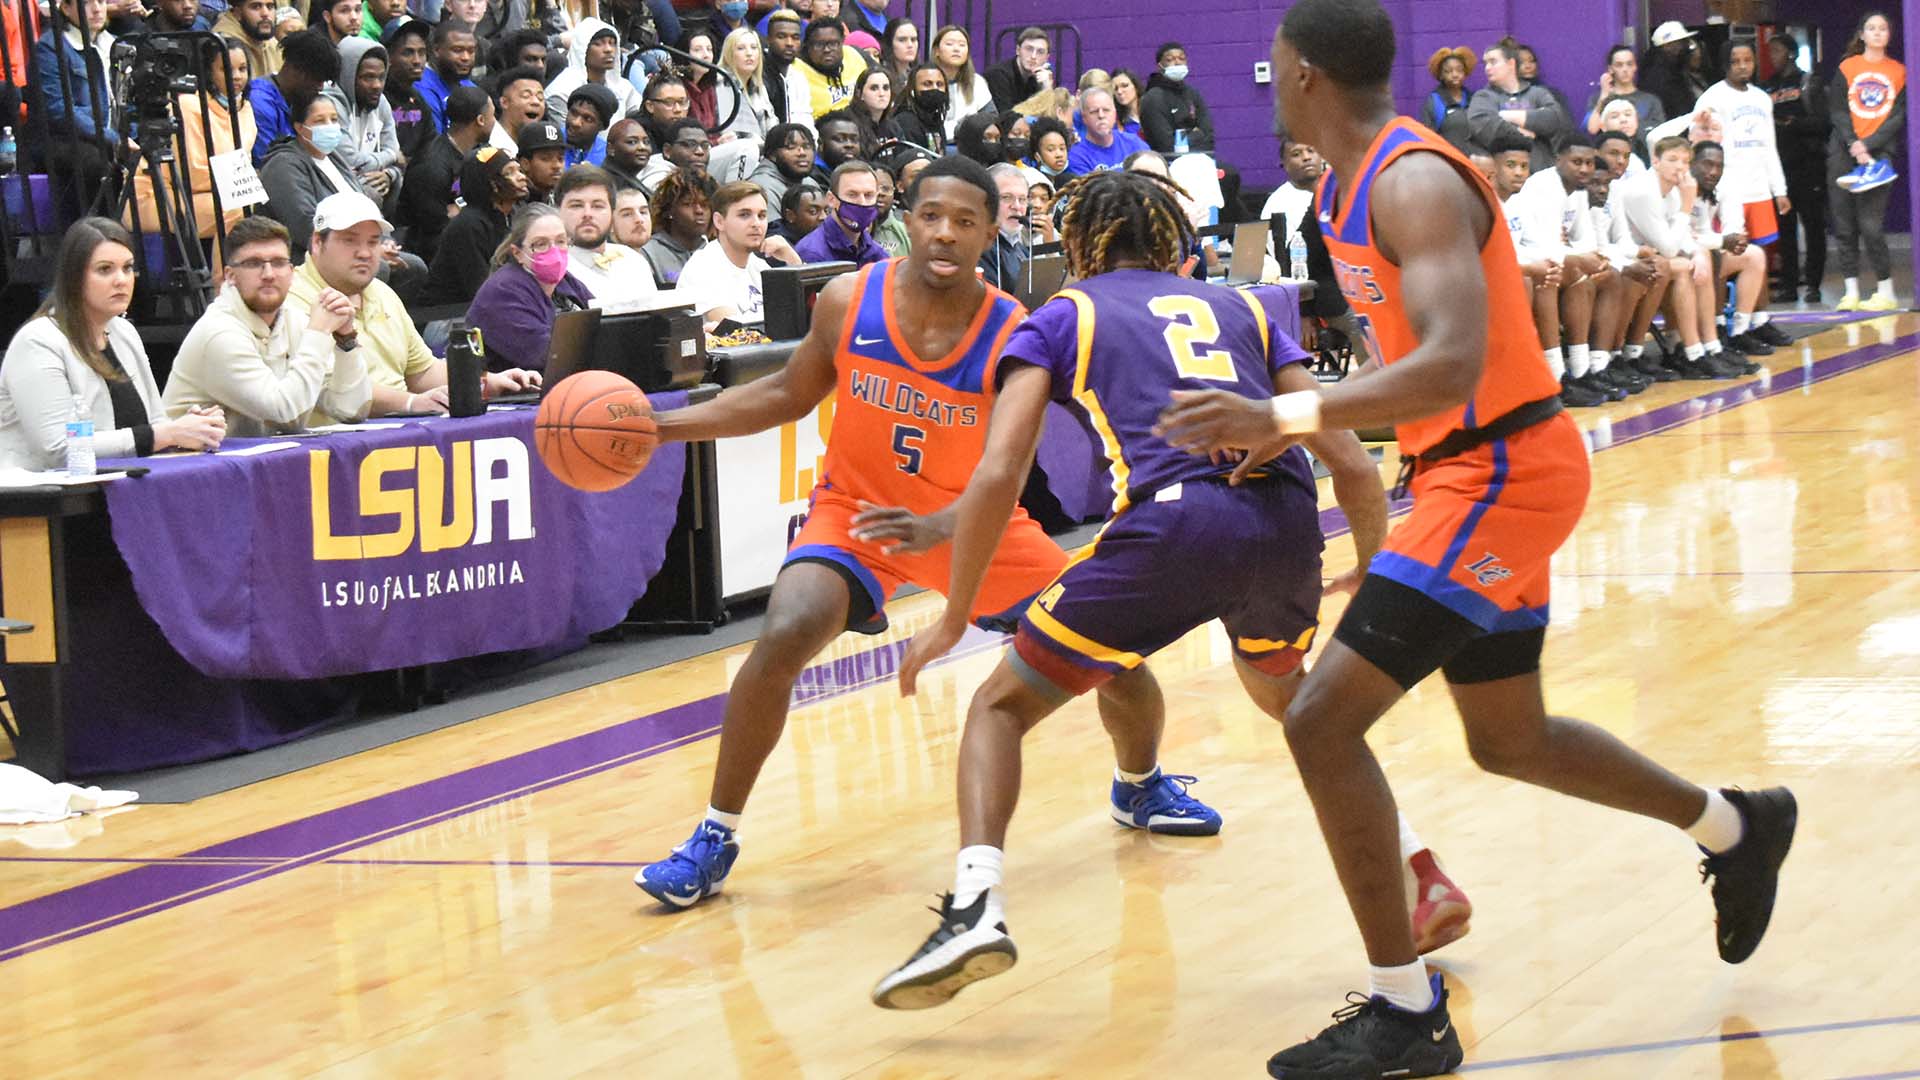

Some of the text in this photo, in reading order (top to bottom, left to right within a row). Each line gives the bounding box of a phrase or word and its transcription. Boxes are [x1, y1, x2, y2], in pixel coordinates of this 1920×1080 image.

[231, 187, 253, 199] FANS
[232, 174, 258, 186] VISIT
[1147, 294, 1239, 382] 2
[851, 369, 977, 426] WILDCATS
[890, 422, 927, 476] 5
[309, 436, 532, 561] LSUA
